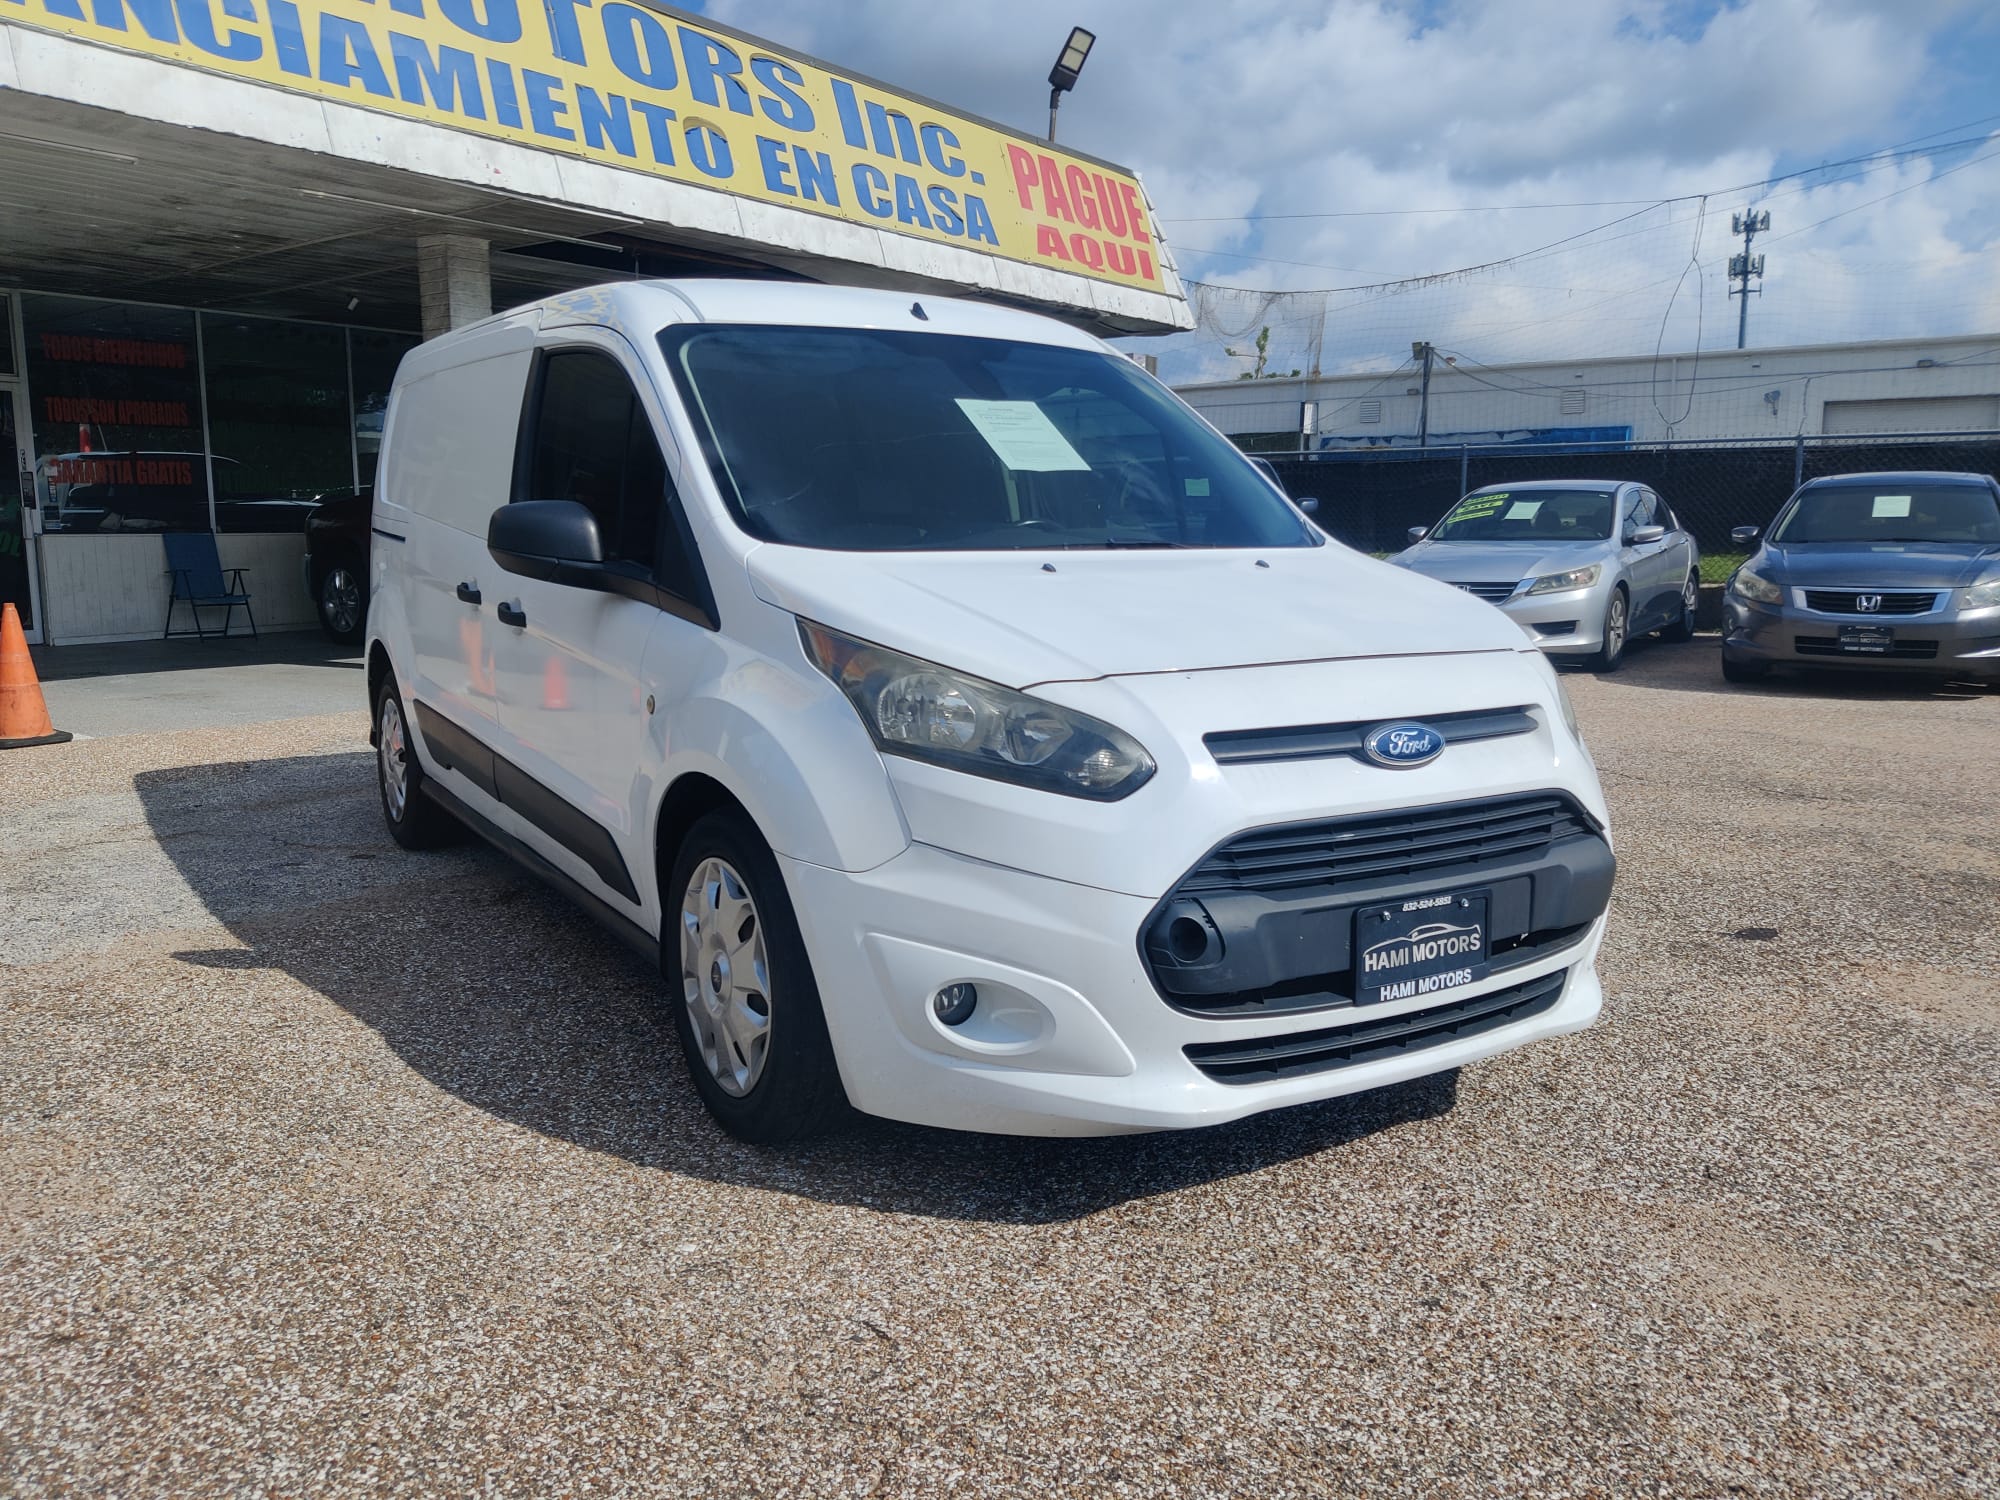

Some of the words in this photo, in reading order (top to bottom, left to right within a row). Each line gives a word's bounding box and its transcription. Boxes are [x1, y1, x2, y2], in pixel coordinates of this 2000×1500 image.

[358, 0, 816, 133] TORS
[830, 79, 987, 184] Inc.
[0, 0, 733, 179] NCIAMIENTO
[756, 135, 840, 207] EN
[852, 163, 1000, 246] CASA
[1007, 143, 1151, 244] PAGUE
[1037, 226, 1155, 281] AQUI
[136, 460, 193, 486] GRATIS
[1389, 731, 1431, 755] Ford
[1364, 949, 1409, 972] HAMI
[1412, 933, 1481, 963] MOTORS
[1380, 980, 1416, 1001] HAMI
[1418, 969, 1472, 994] MOTORS
